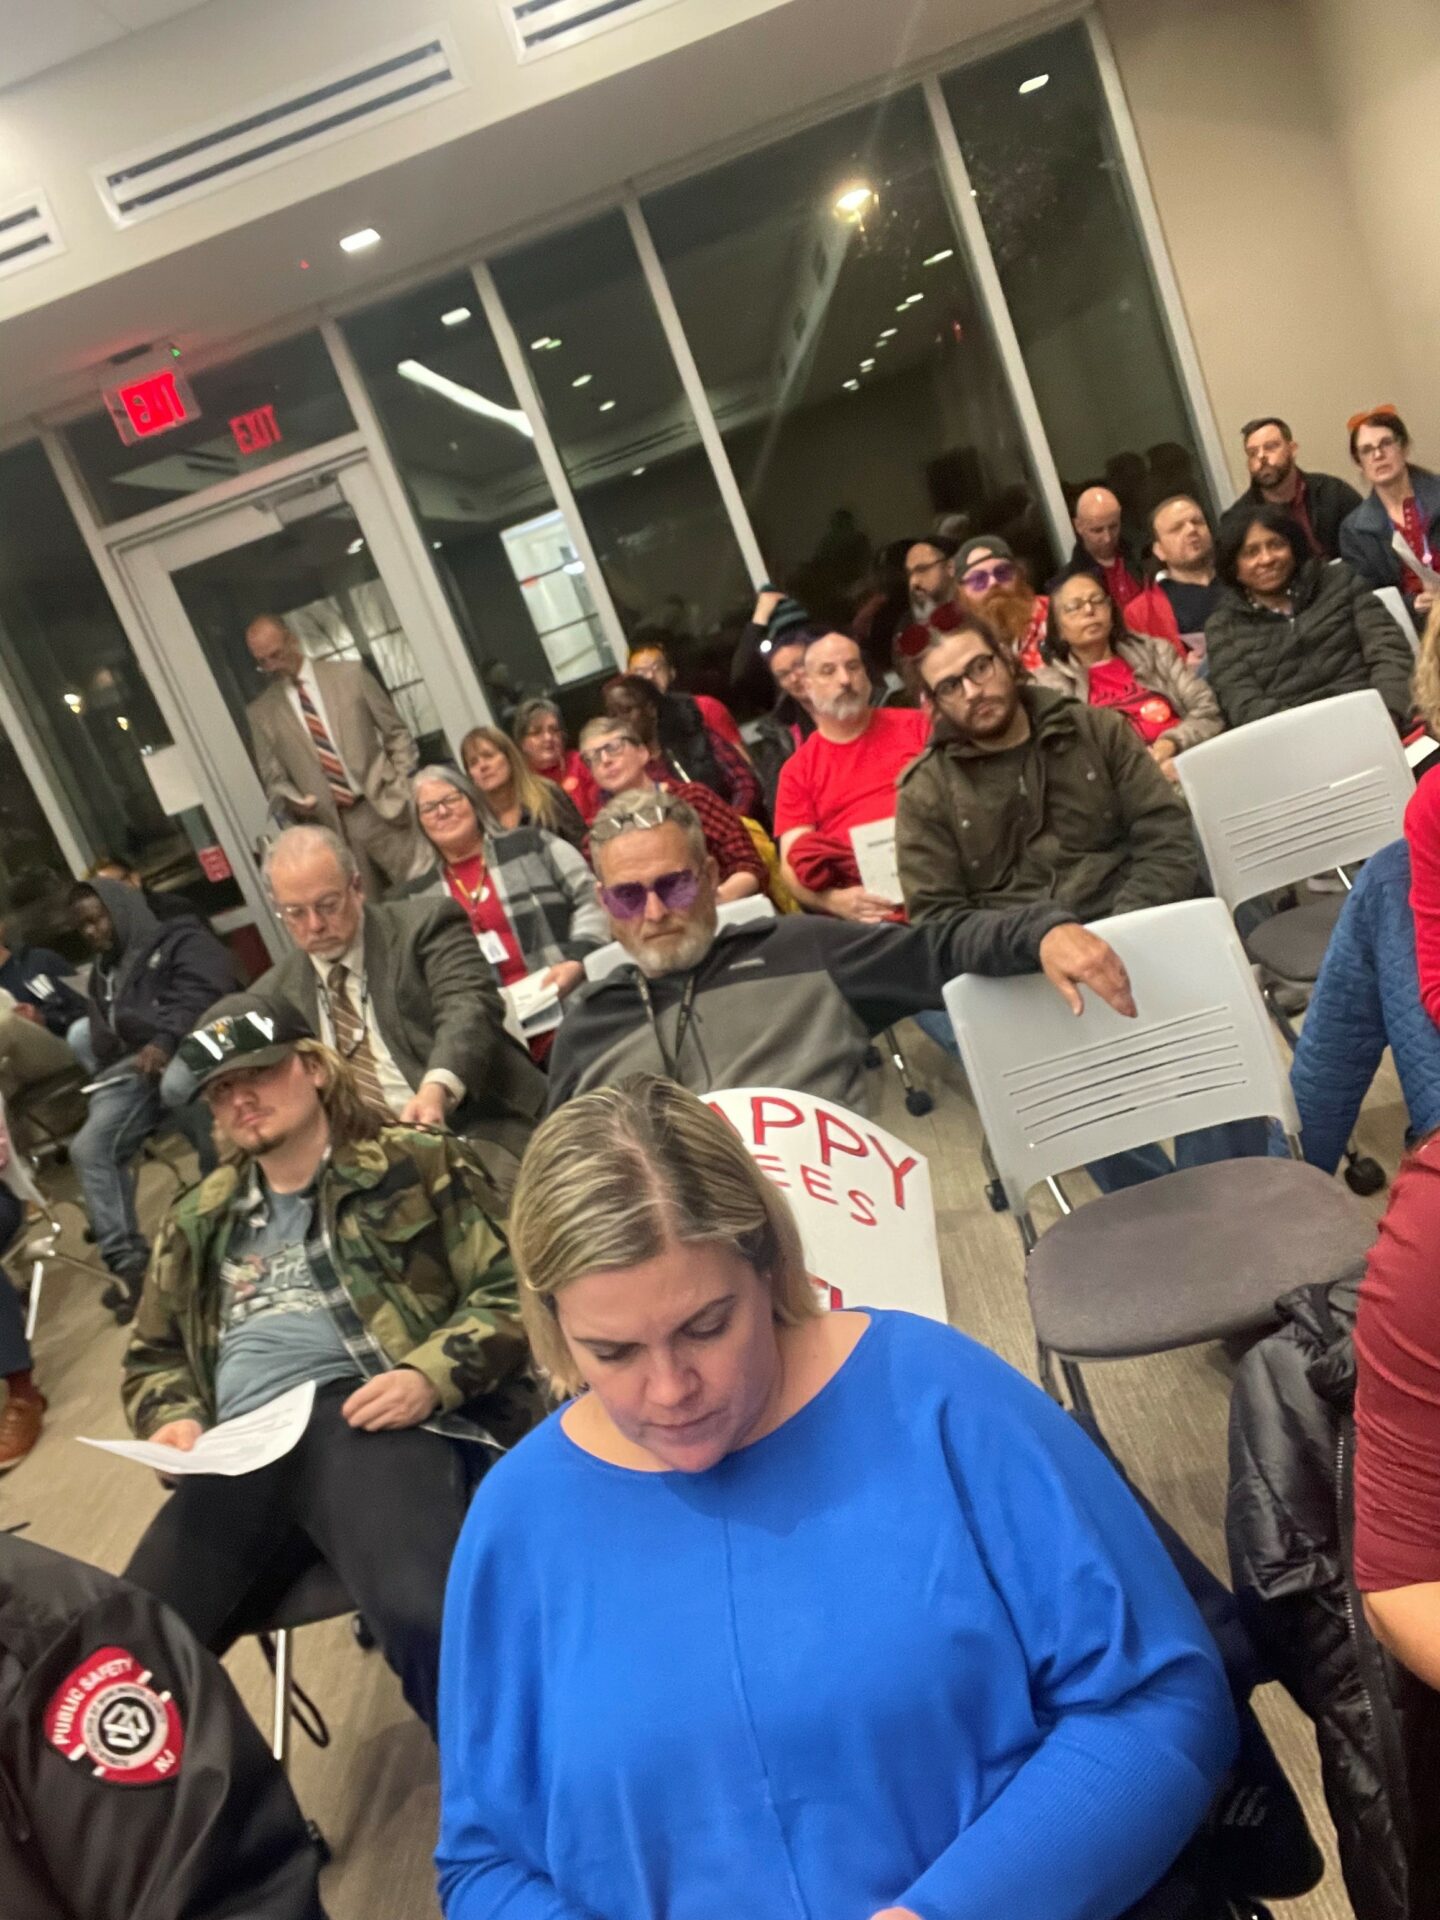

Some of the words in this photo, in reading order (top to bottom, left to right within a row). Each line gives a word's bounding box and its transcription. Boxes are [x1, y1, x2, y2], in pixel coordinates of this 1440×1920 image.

[119, 370, 187, 437] EXIT
[228, 404, 282, 455] EXIT
[52, 1687, 86, 1745] PUBLIC
[78, 1657, 134, 1691] SAFETY
[153, 1748, 176, 1773] NJ
